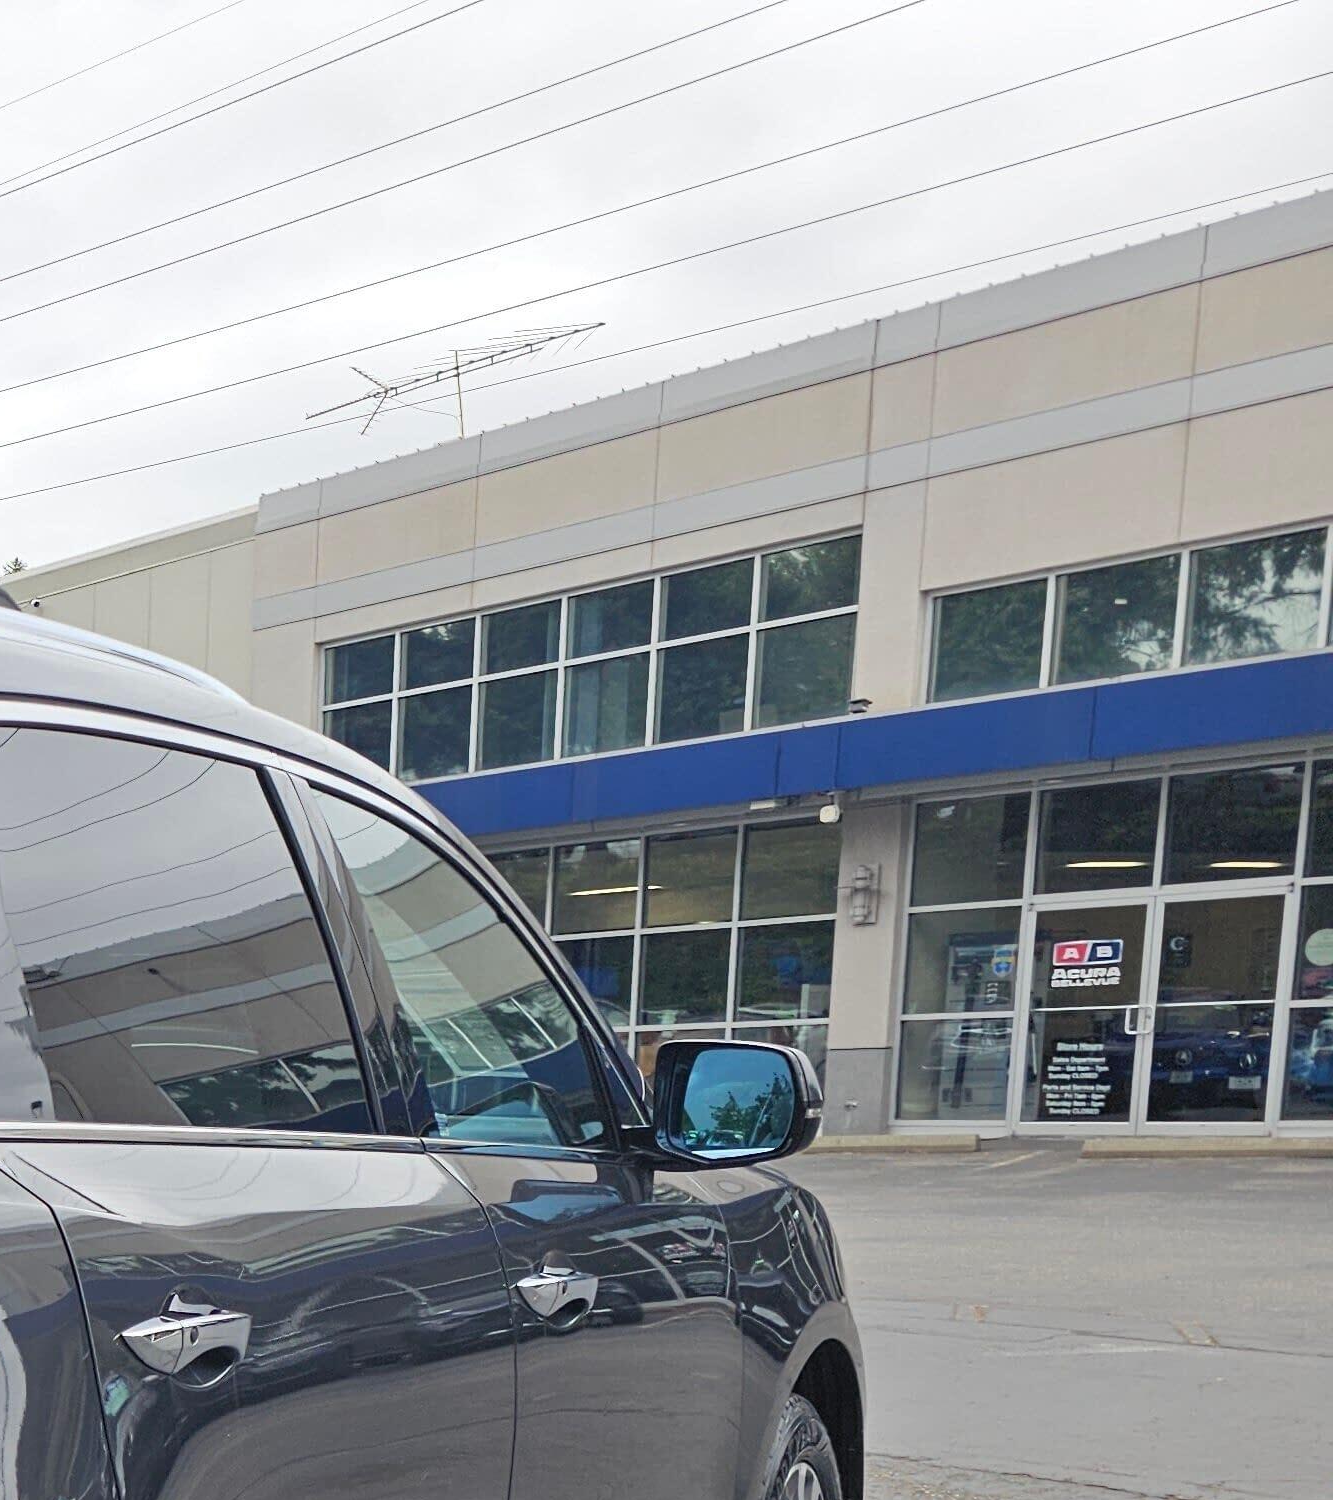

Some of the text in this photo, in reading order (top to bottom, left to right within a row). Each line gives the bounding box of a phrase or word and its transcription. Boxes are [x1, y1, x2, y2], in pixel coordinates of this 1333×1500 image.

[1063, 947, 1079, 960] A
[1051, 966, 1122, 980] ACURA
[1051, 977, 1120, 988] BELLEVUE
